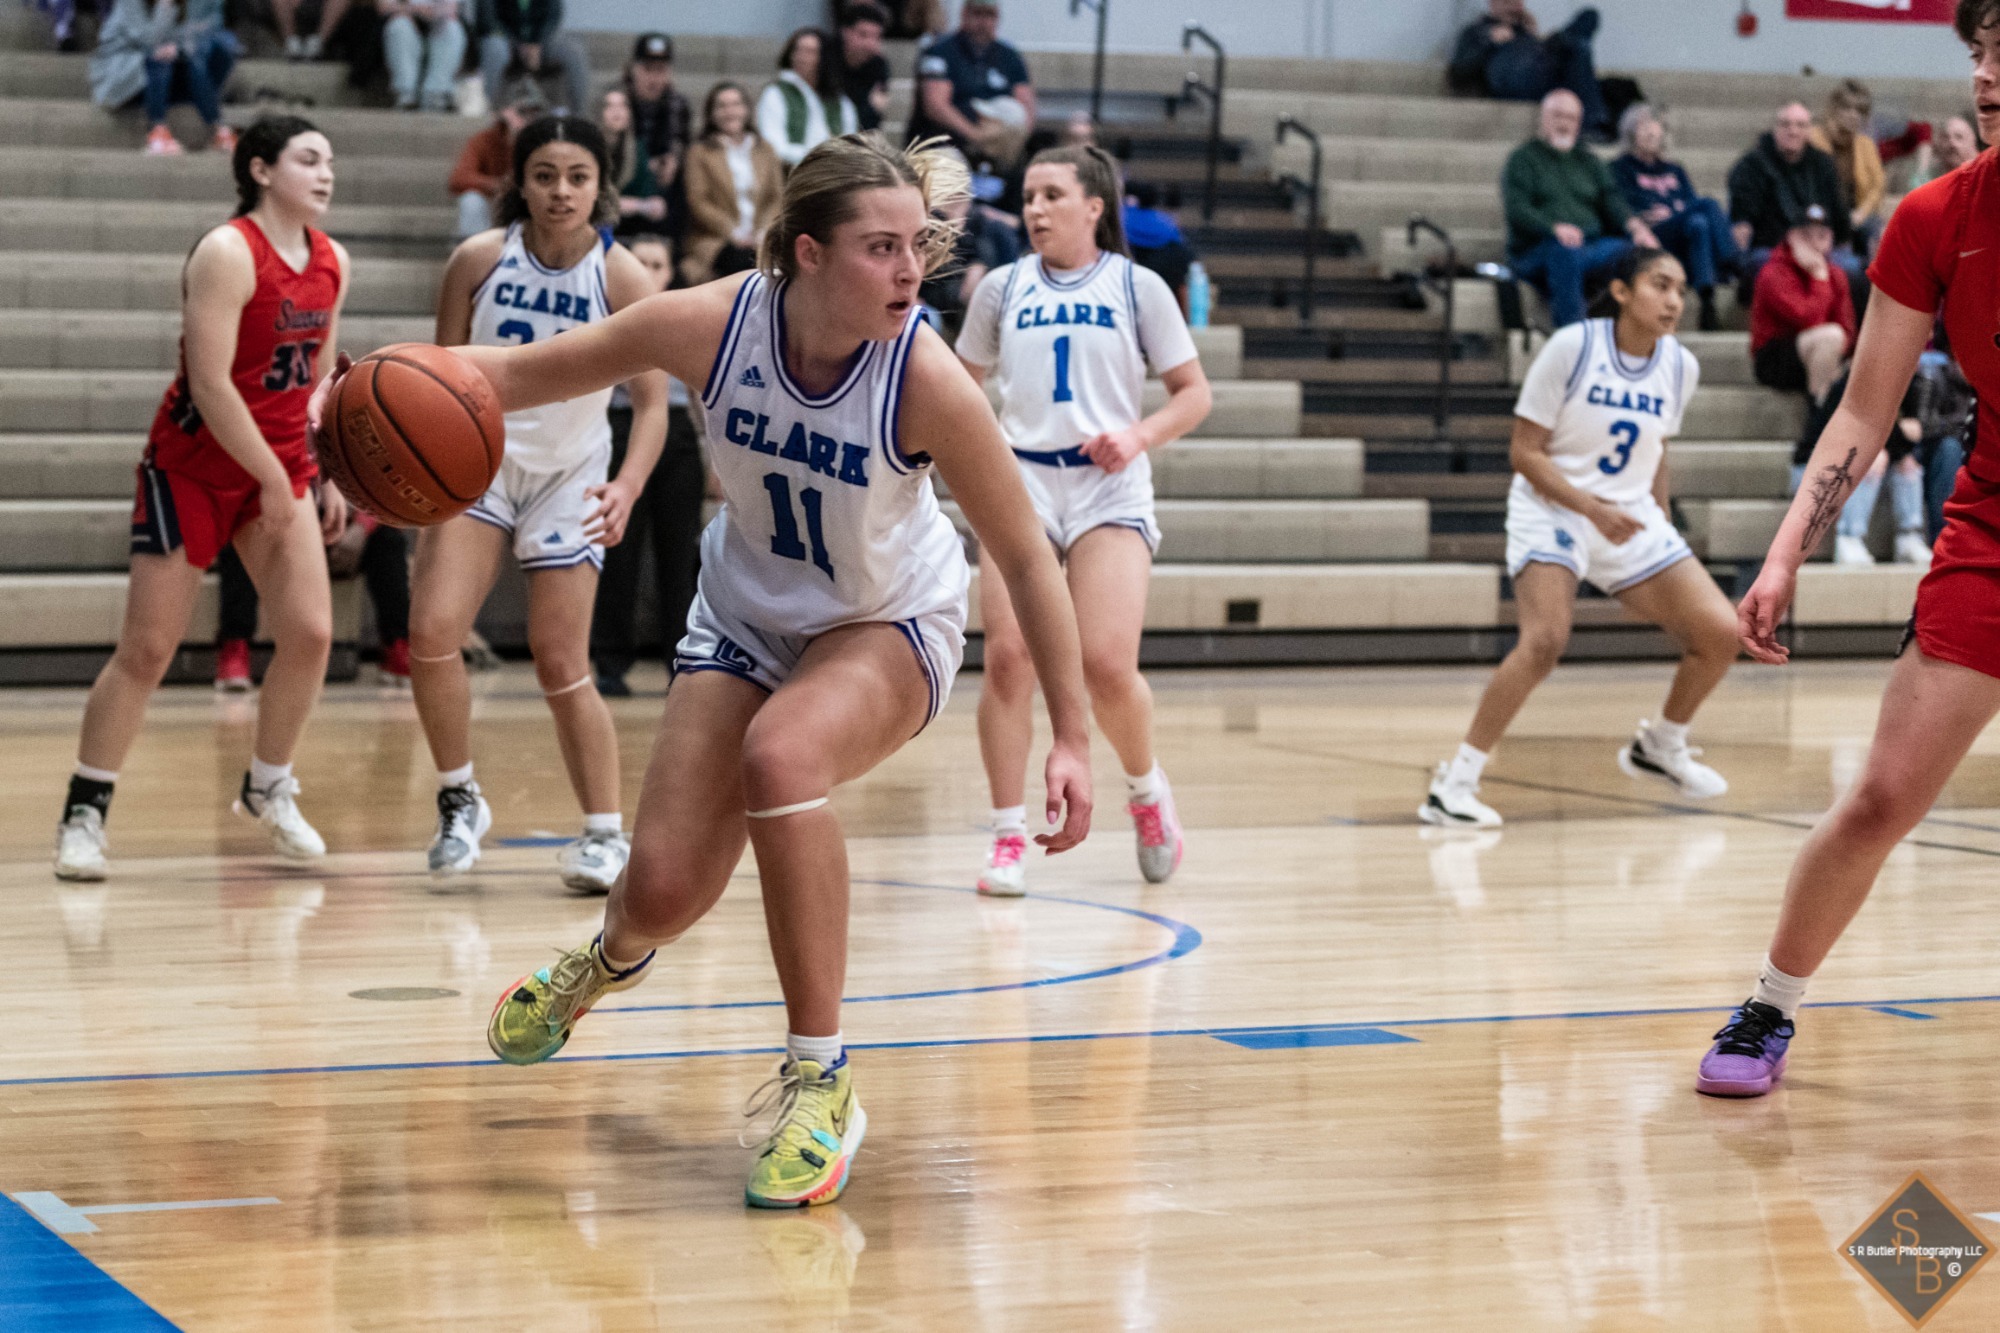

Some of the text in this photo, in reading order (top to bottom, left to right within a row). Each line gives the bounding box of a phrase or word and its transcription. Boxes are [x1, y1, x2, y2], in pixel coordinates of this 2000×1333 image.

[494, 281, 591, 323] CLARK
[1017, 303, 1116, 330] CLARK
[1052, 335, 1073, 403] 1
[725, 407, 870, 487] CLARK
[1597, 419, 1640, 476] 3
[763, 472, 835, 583] 11
